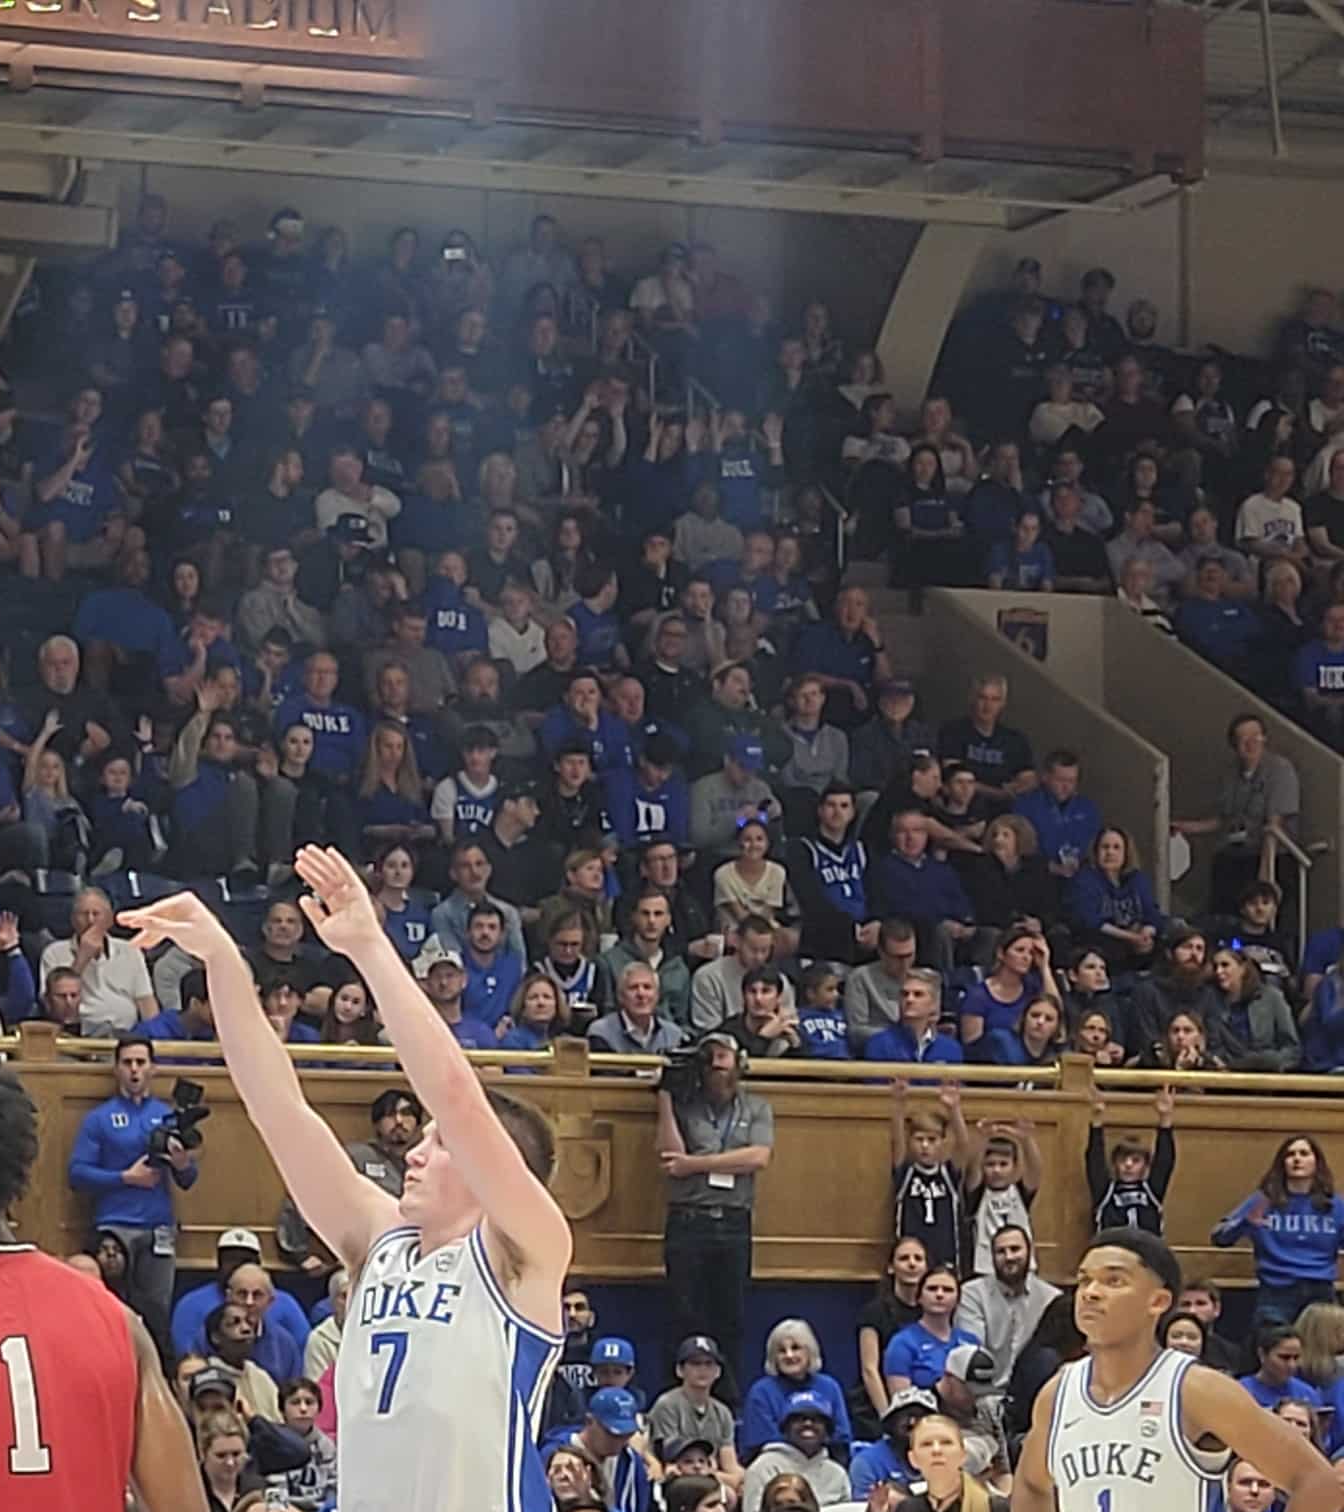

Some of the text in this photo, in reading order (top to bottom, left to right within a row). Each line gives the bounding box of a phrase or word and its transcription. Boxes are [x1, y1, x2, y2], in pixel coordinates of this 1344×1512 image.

[303, 712, 350, 733] DUKE
[924, 1198, 935, 1224] 1
[1267, 1213, 1337, 1235] DUKE
[360, 1280, 461, 1327] DUKE
[603, 1343, 620, 1358] D
[369, 1331, 410, 1414] 7
[1060, 1443, 1162, 1488] DUKE
